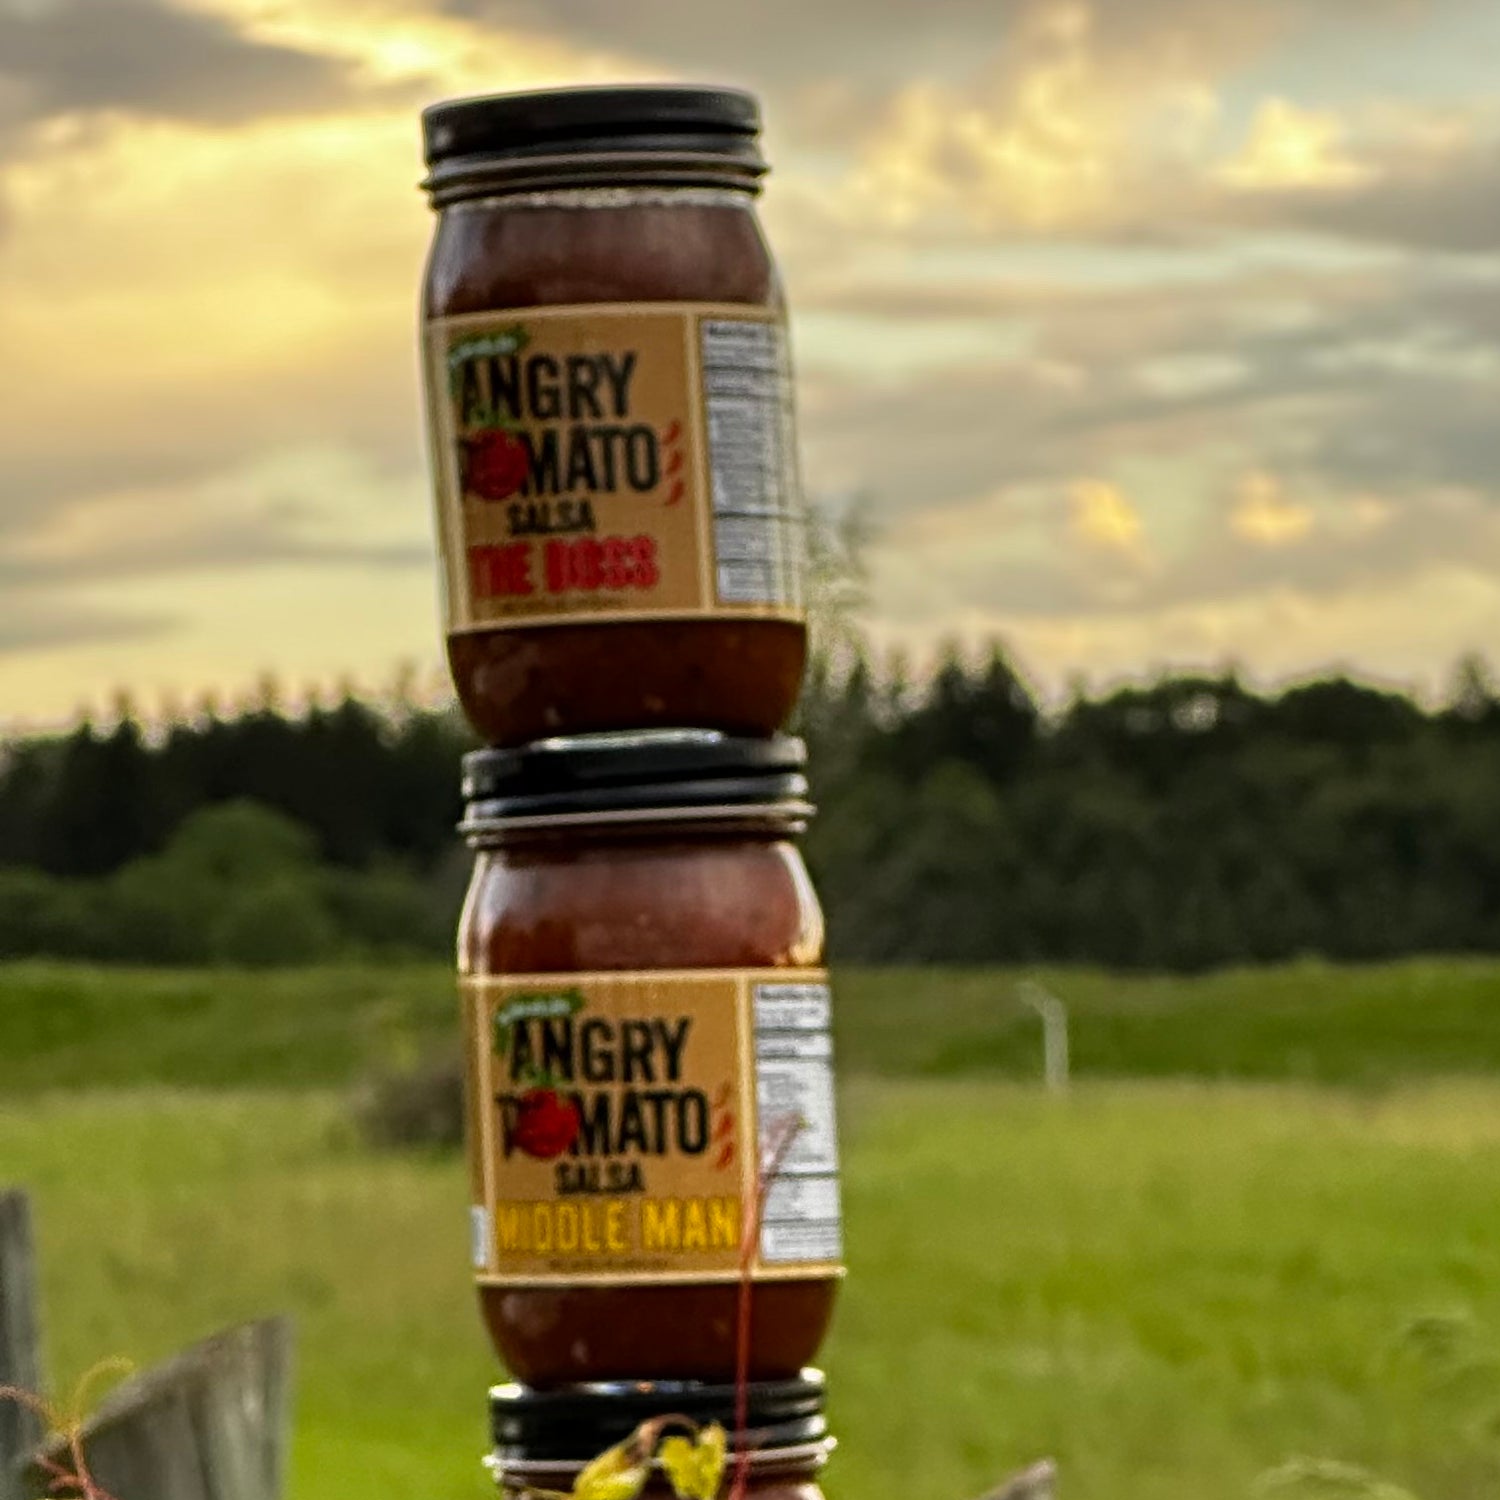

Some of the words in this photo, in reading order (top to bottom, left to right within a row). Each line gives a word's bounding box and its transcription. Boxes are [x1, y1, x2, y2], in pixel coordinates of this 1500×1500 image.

[462, 350, 637, 424] ANGRY
[511, 1016, 694, 1083] ANGRY
[640, 1198, 741, 1252] MAN
